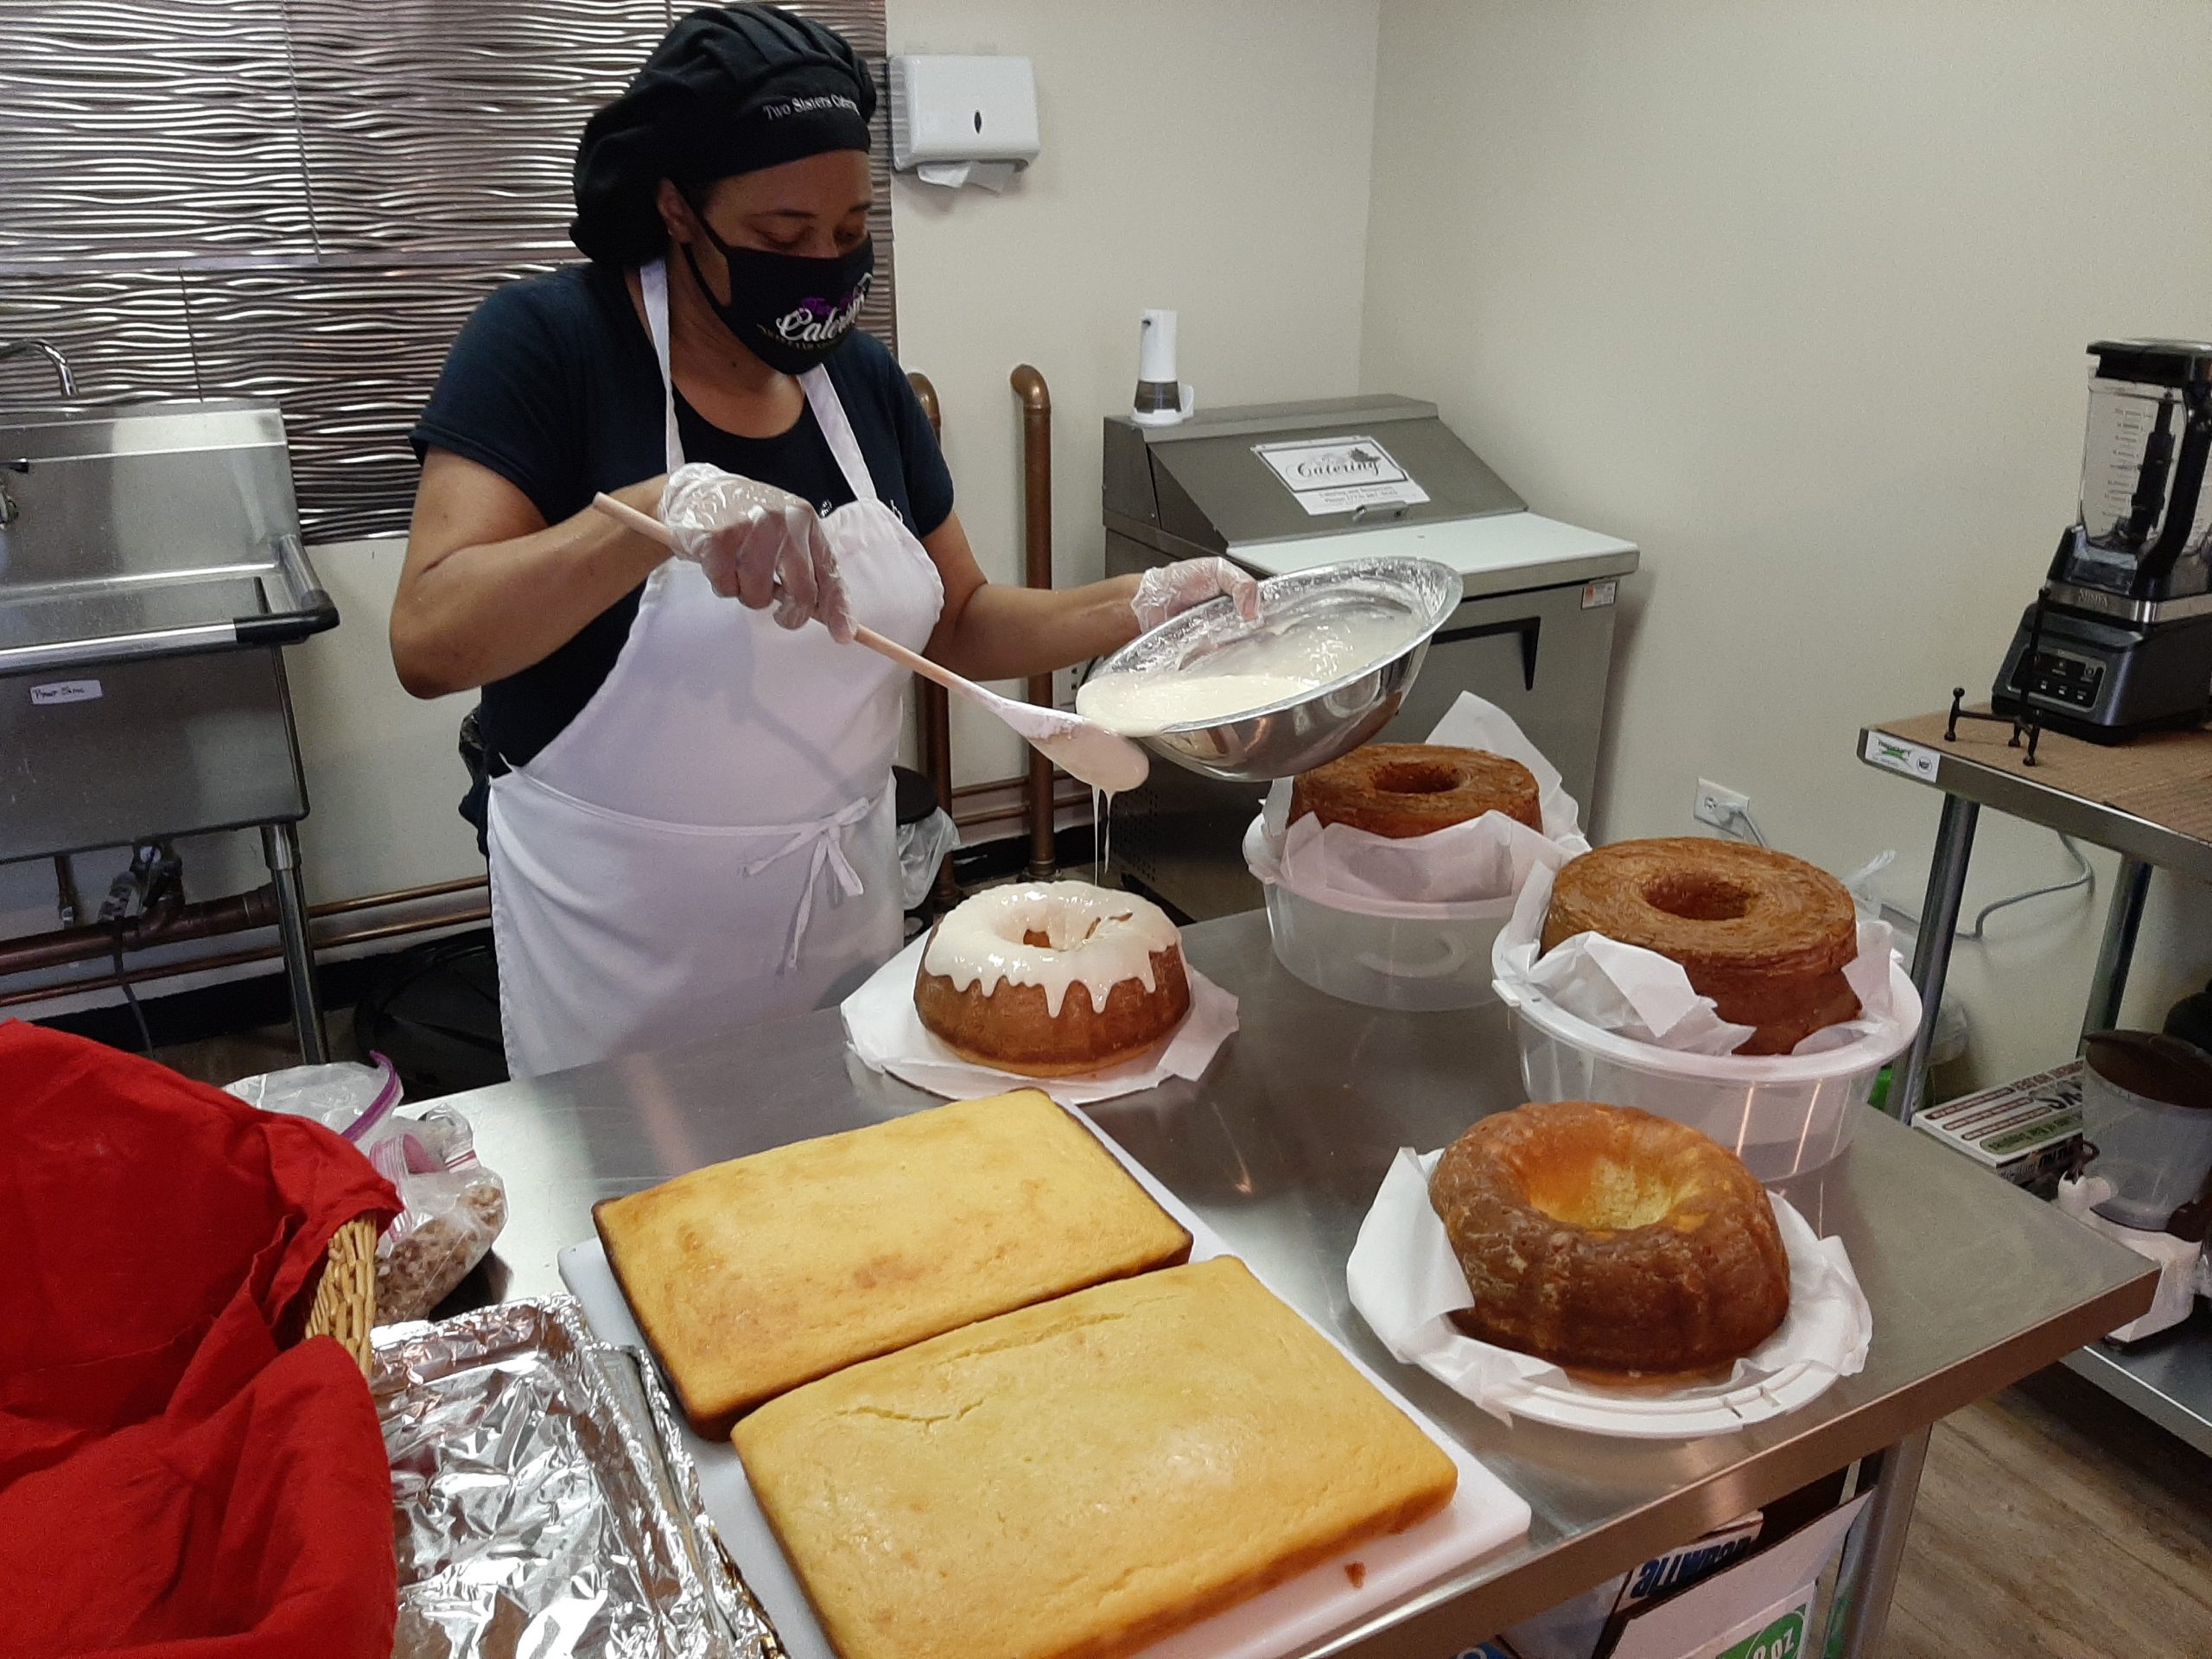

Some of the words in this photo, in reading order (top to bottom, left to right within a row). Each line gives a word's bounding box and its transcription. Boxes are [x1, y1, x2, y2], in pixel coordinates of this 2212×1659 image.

[762, 105, 791, 120] Two
[791, 97, 833, 113] Sisters
[1297, 459, 1380, 477] Catering
